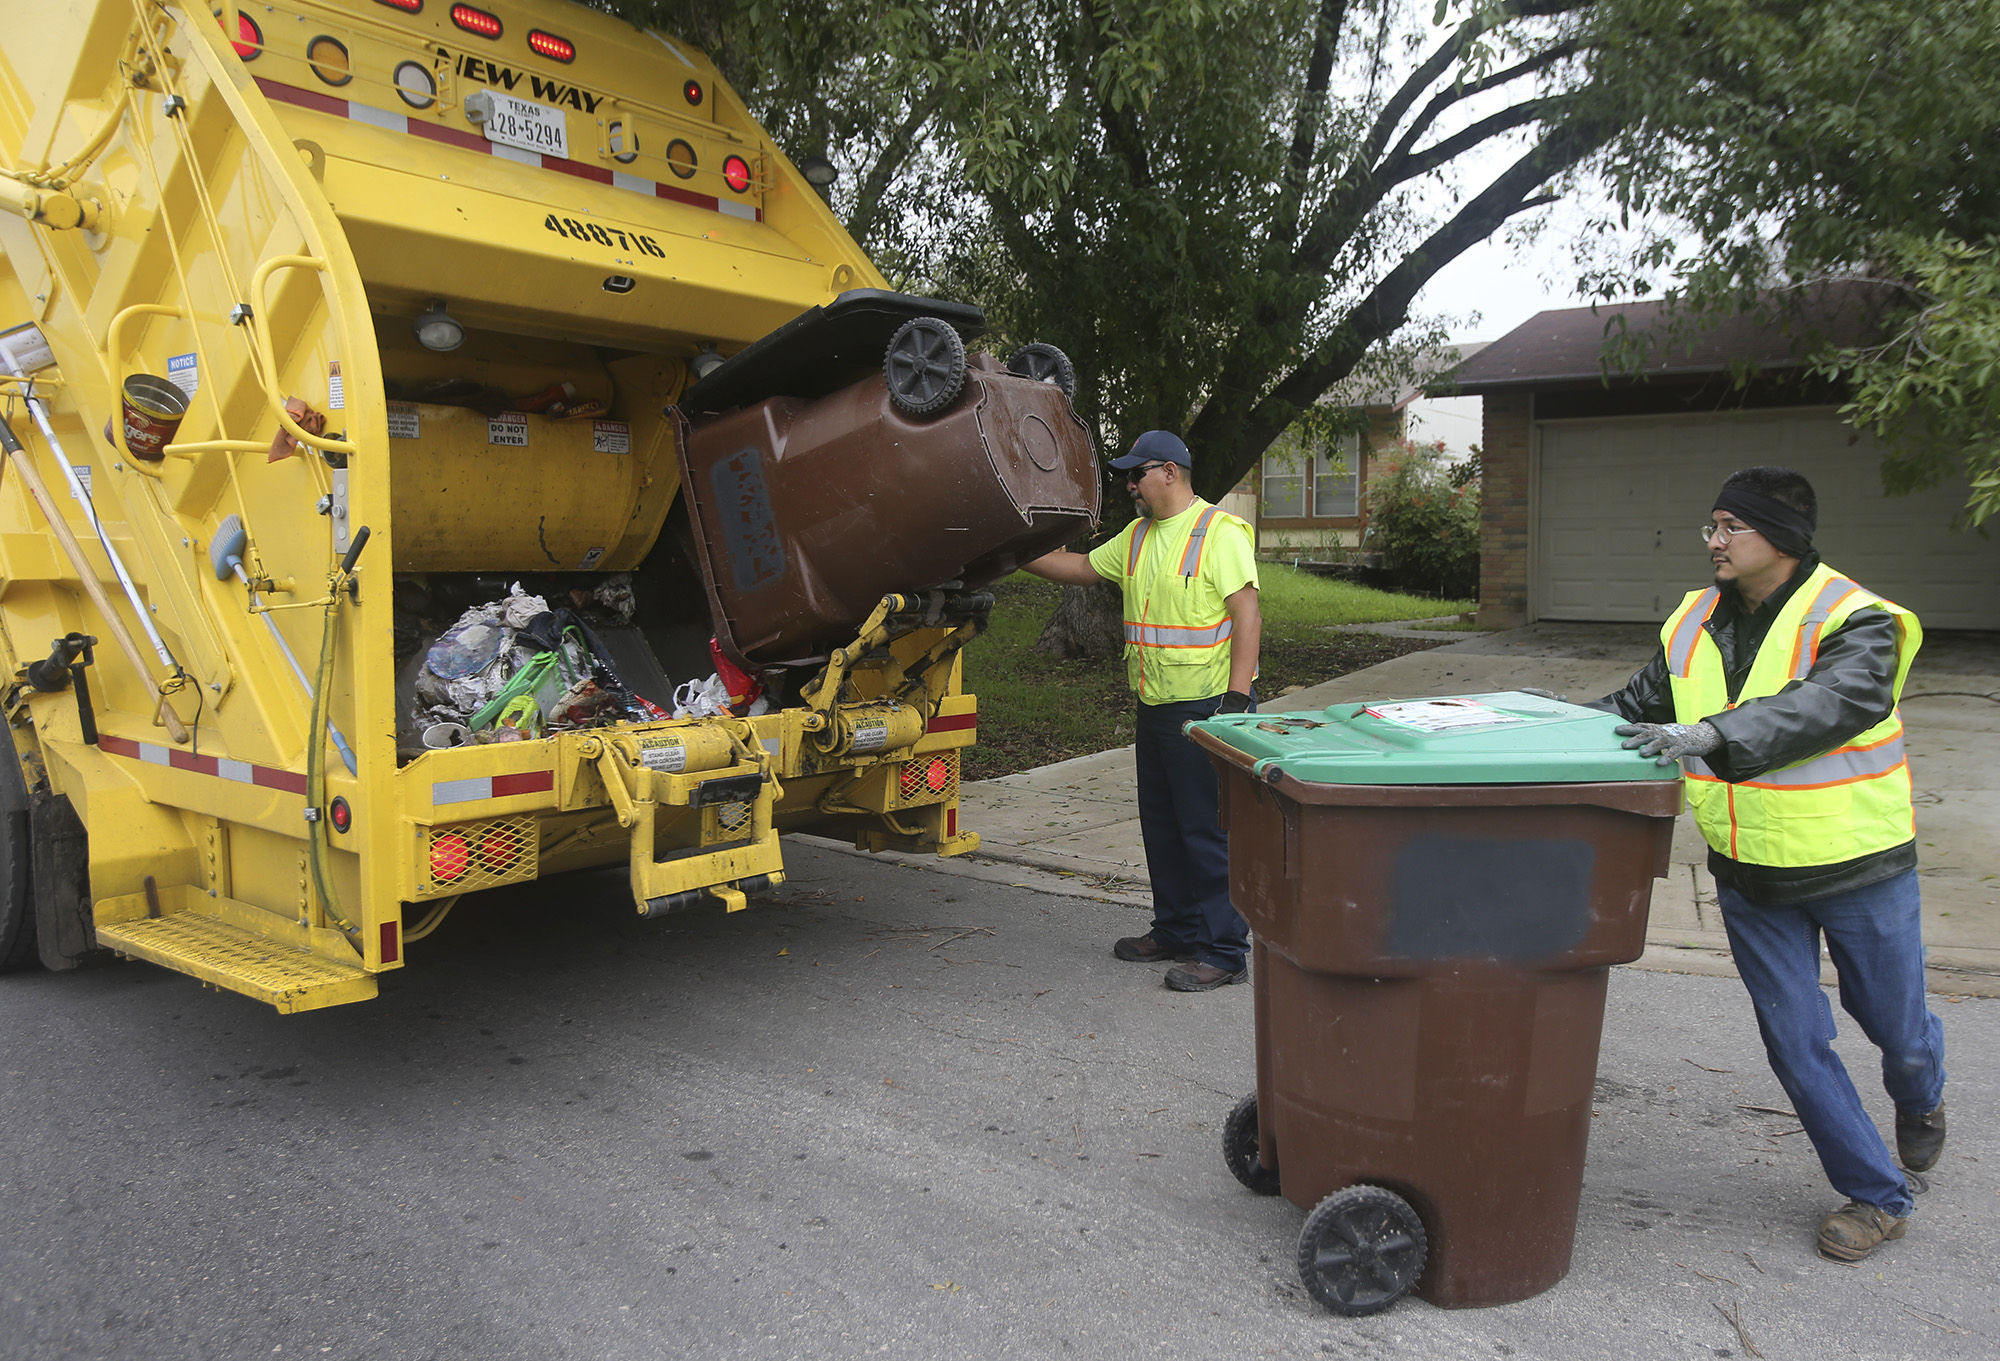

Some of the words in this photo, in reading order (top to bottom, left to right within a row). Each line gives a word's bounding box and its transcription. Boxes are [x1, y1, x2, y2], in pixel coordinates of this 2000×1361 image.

[434, 47, 523, 91] NEW
[530, 75, 603, 115] WAY
[508, 100, 540, 117] TEXAS
[544, 213, 666, 259] 488716
[170, 356, 195, 370] NOTICE
[497, 413, 527, 424] DANGER
[491, 424, 504, 432] DO
[507, 425, 525, 434] NOT
[602, 424, 627, 432] DANGER
[493, 435, 524, 444] ENTER
[861, 720, 884, 728] CAUTION
[649, 737, 680, 749] CAUTION
